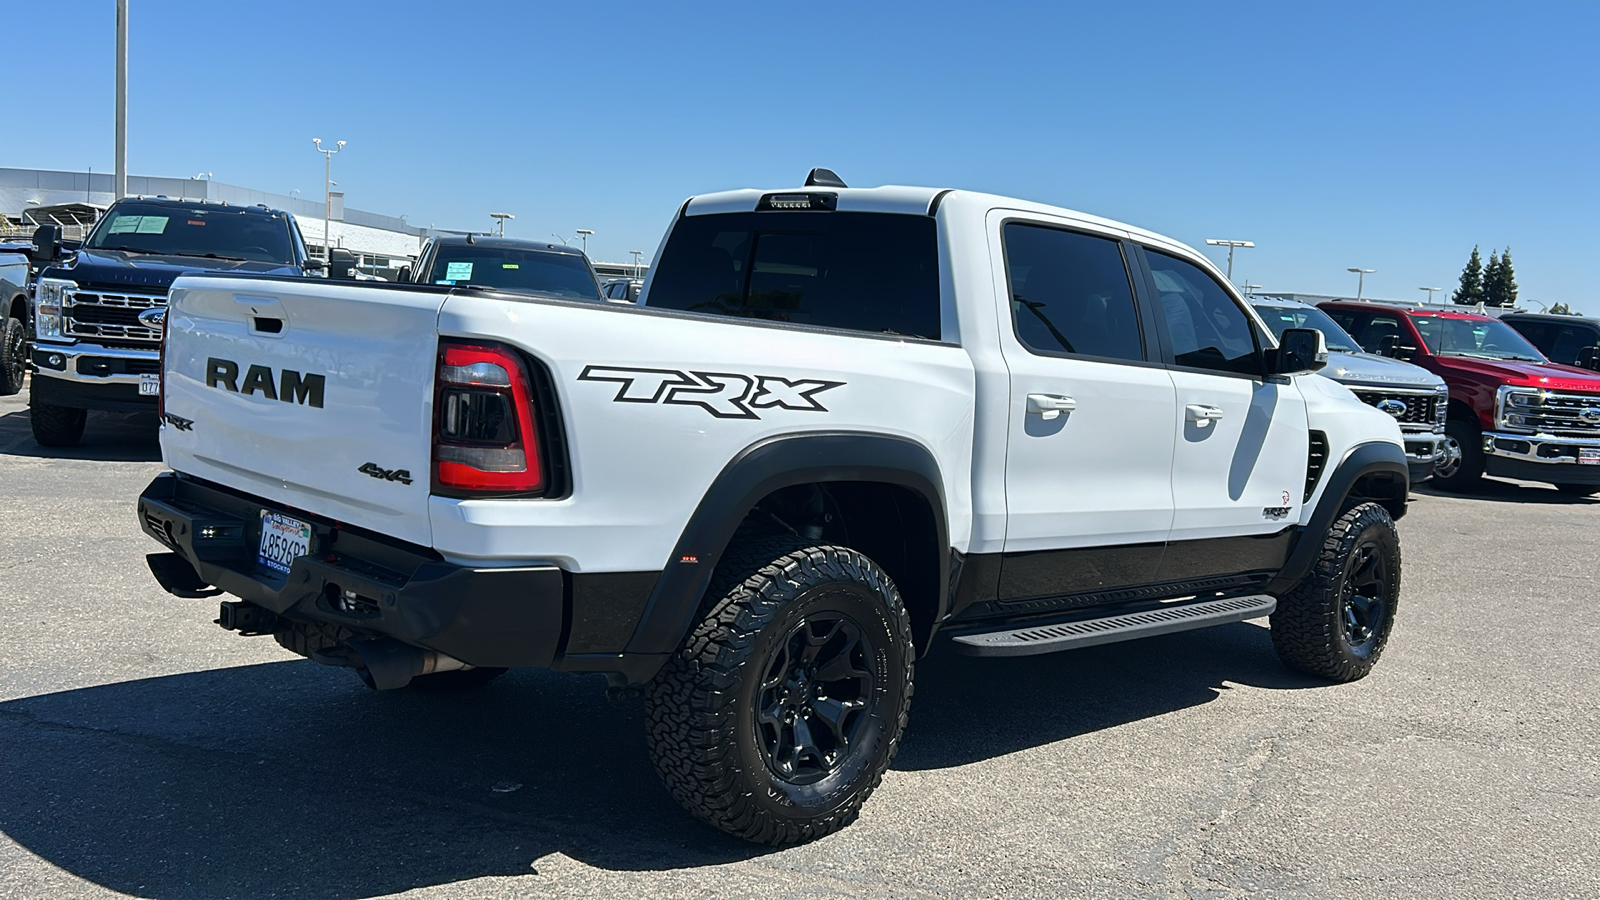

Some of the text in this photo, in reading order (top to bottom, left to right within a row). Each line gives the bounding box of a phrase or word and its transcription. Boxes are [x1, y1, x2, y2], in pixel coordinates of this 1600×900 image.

[206, 356, 326, 409] RAM
[576, 364, 848, 421] TRX
[282, 516, 300, 527] VALLEY
